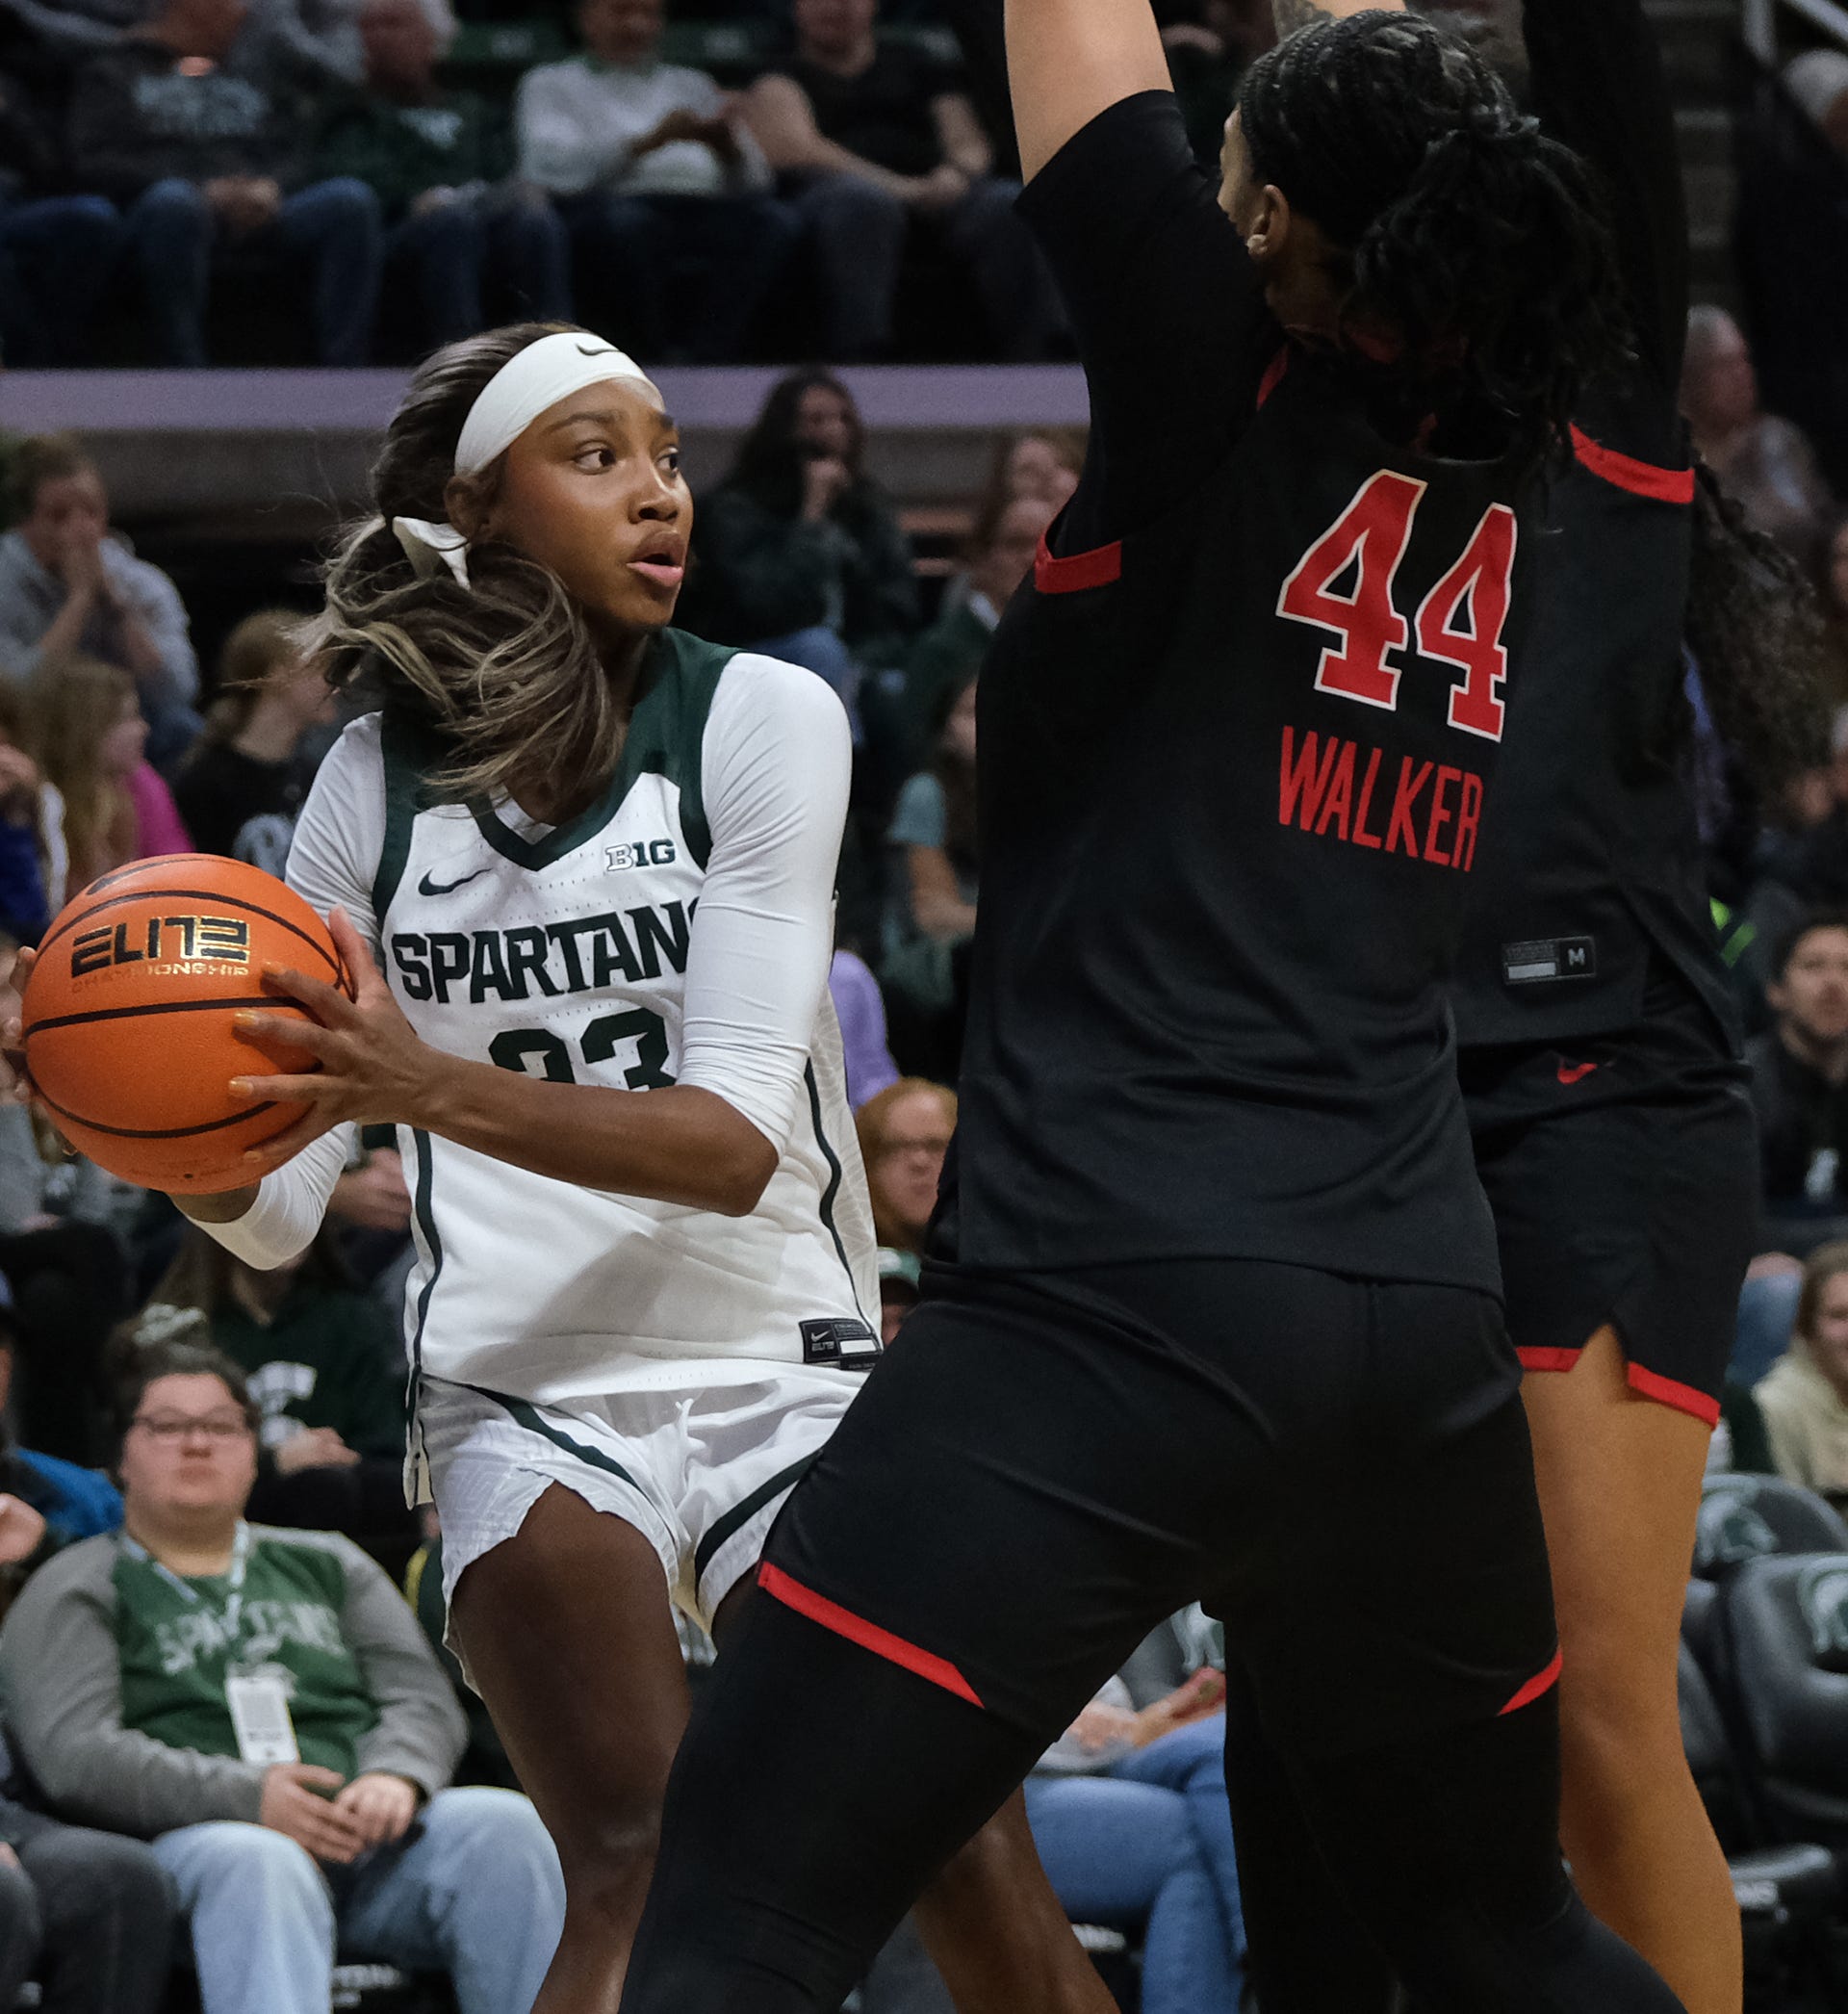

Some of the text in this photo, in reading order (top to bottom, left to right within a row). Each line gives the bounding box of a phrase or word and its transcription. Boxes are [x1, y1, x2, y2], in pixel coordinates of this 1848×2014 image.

[1275, 468, 1518, 743] 44
[1278, 725, 1483, 872] WALKER
[71, 915, 250, 978] ELITE
[1568, 947, 1585, 966] M
